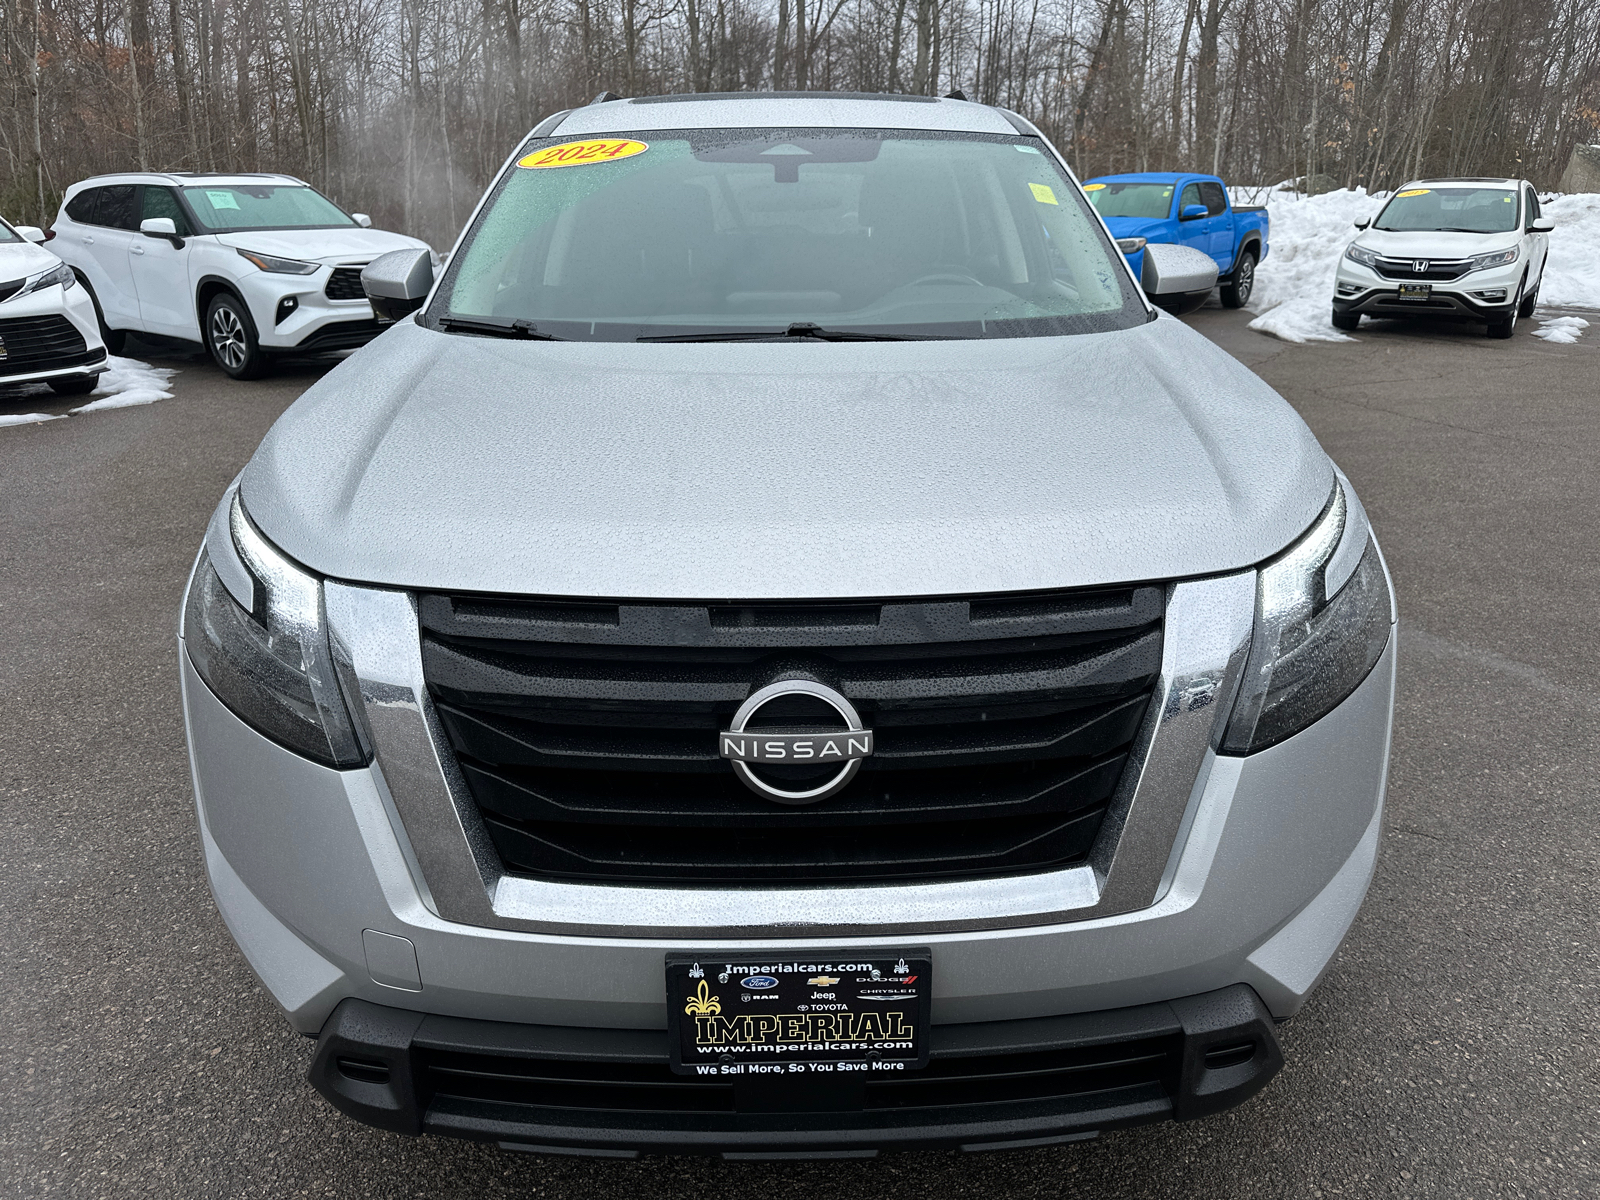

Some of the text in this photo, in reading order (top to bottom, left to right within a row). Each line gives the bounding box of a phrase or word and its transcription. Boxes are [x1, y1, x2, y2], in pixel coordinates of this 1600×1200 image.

[534, 142, 629, 165] 2024
[724, 736, 869, 759] NISSAN
[725, 963, 873, 976] Imperialcars.com
[811, 991, 836, 1001] Jeep
[811, 1003, 848, 1011] TOYOTA
[695, 1012, 913, 1044] IMPERIAL
[697, 1041, 913, 1053] www.imperialcars.com
[696, 1061, 905, 1075] We Sell More, So You Save More
